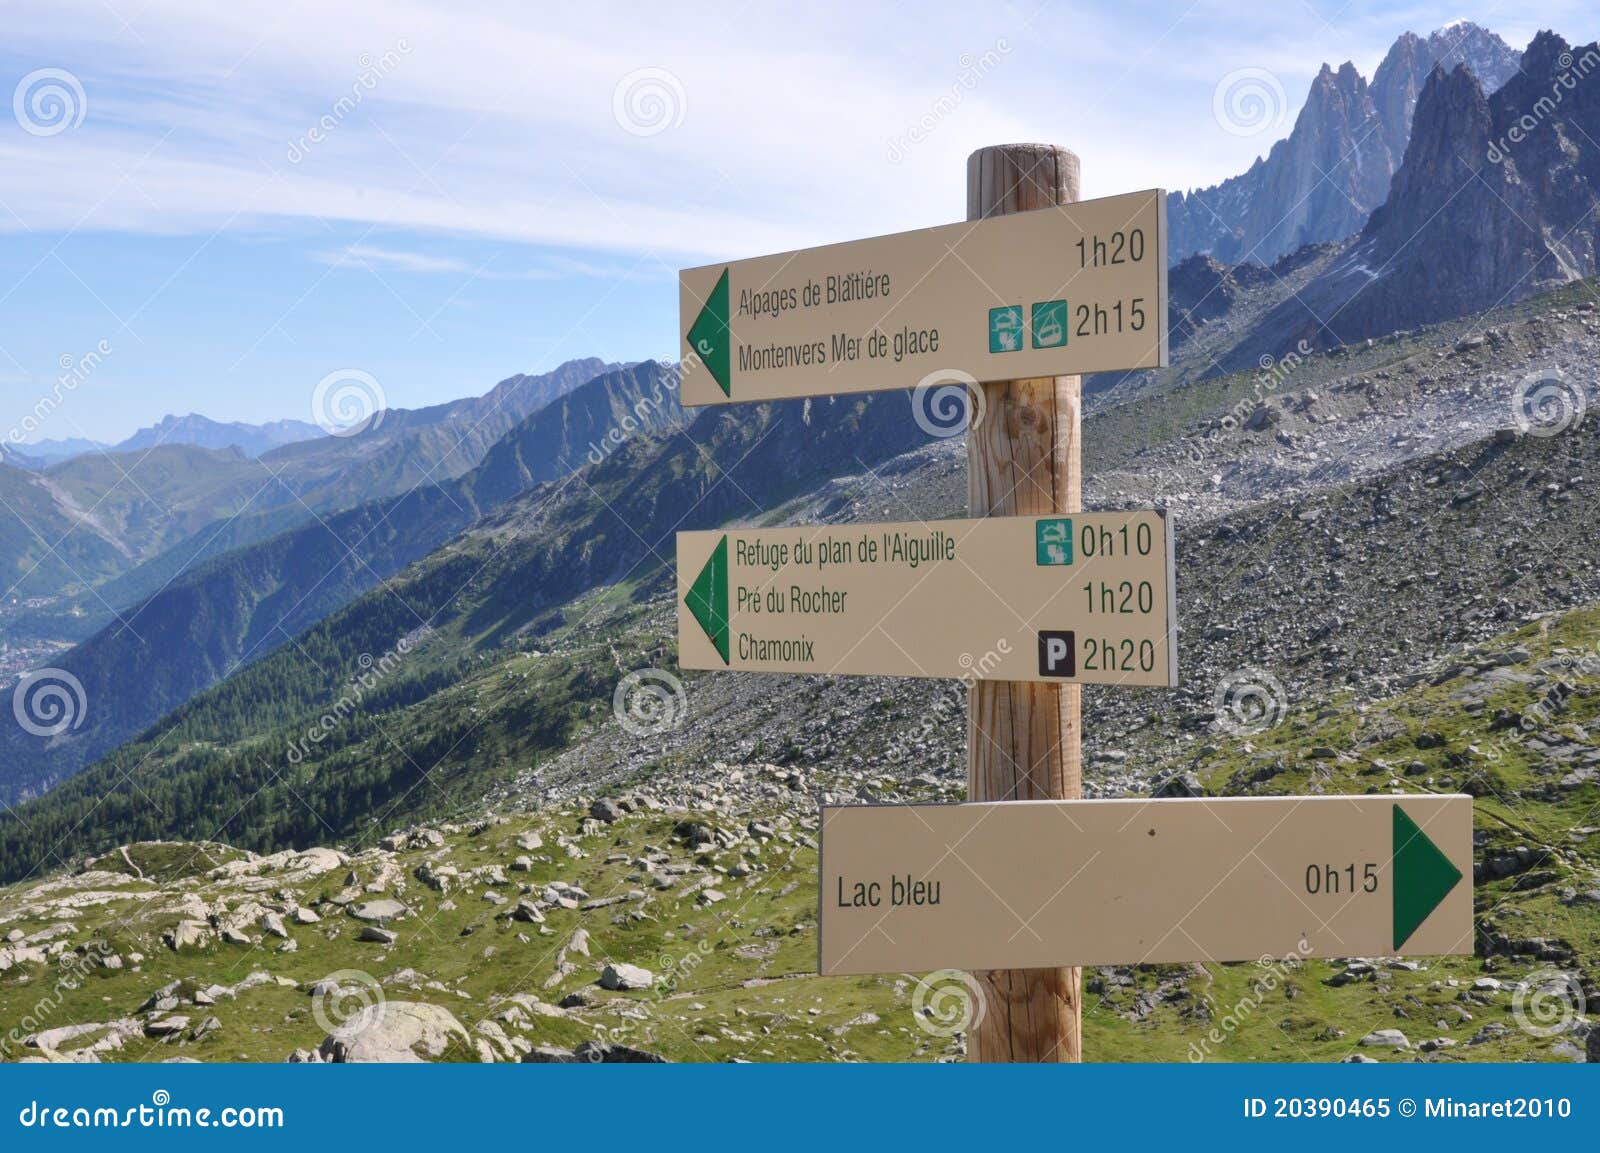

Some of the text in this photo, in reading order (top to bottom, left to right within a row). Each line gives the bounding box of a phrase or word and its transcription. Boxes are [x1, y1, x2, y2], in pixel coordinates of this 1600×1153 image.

[1075, 229, 1145, 268] 1h20
[738, 287, 797, 320] Alpages
[802, 279, 821, 307] de
[1076, 298, 1145, 337] 2h15
[738, 325, 939, 372] Montenvers Mer de glace
[736, 530, 955, 572] Refuge du plan de l'Aiguille
[1081, 522, 1152, 558] 0h10
[737, 585, 848, 614] Pré du Rocher
[1082, 580, 1153, 615] 1h20
[738, 632, 815, 663] Chamonix
[1047, 639, 1067, 671] P
[1083, 638, 1155, 673] 2h20
[838, 874, 941, 908] Lac bleu
[1305, 863, 1378, 895] 0h15
